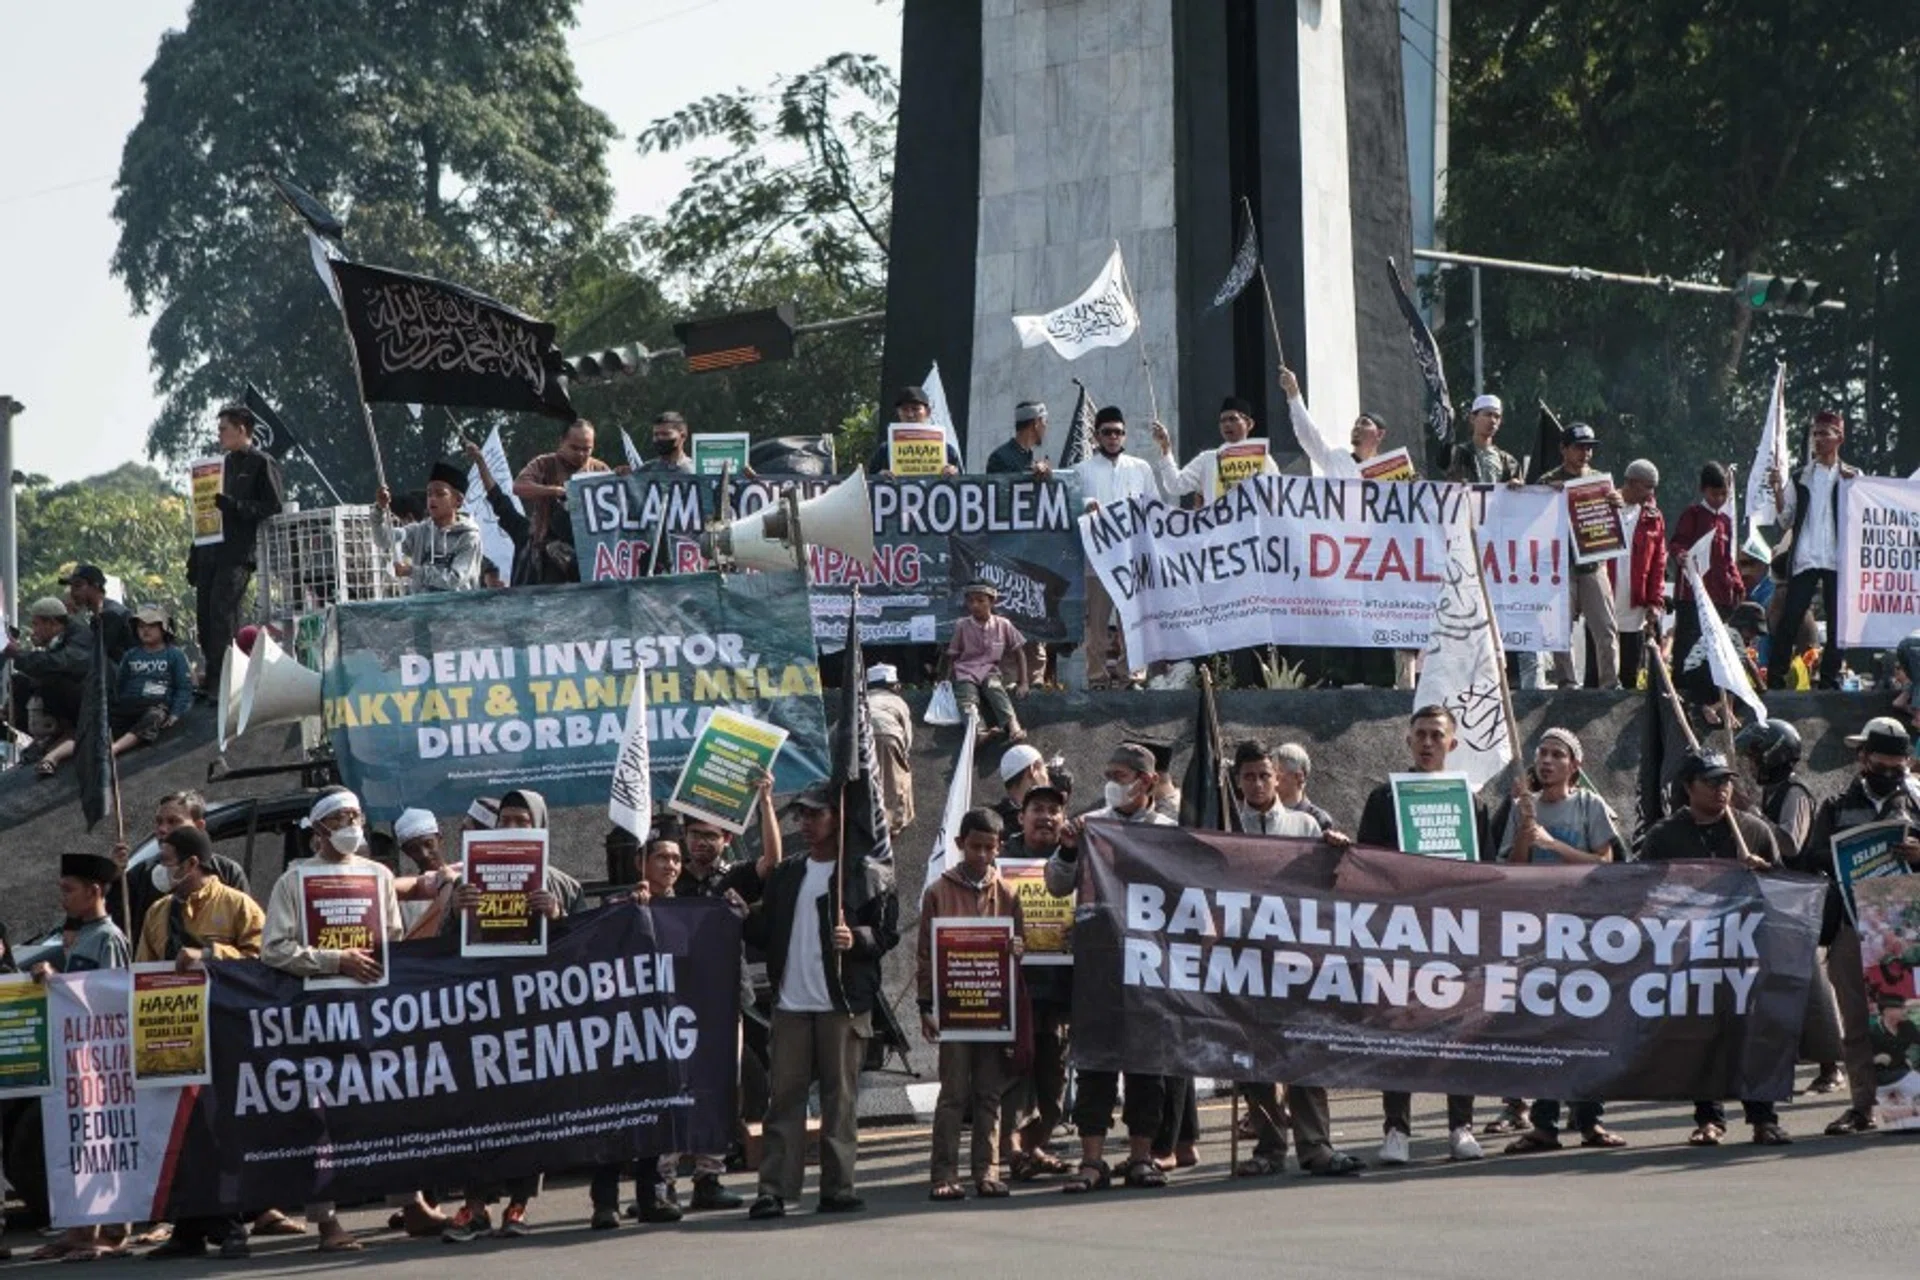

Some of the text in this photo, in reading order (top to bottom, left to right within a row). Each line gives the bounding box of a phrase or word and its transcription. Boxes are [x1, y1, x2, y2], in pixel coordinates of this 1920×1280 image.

[584, 483, 701, 533] ISLAM
[874, 482, 1070, 533] PROBLEM
[128, 659, 168, 671] TOKYO
[401, 632, 761, 686] DEMI INVESTOR,
[484, 684, 518, 717] &
[528, 669, 681, 714] TANAH
[1852, 841, 1888, 866] ISLAM
[1126, 882, 1765, 965] BATALKAN PROYEK
[1123, 936, 1760, 1019] REMPANG ECO CITY
[139, 993, 199, 1013] HARAM
[250, 1002, 362, 1048] ISLAM
[371, 979, 502, 1038] SOLUSI
[234, 1005, 699, 1116] AGRARIA REMPANG
[66, 1072, 136, 1109] BOGOR
[69, 1108, 137, 1142] PEDULI
[69, 1141, 140, 1175] UMMAT
